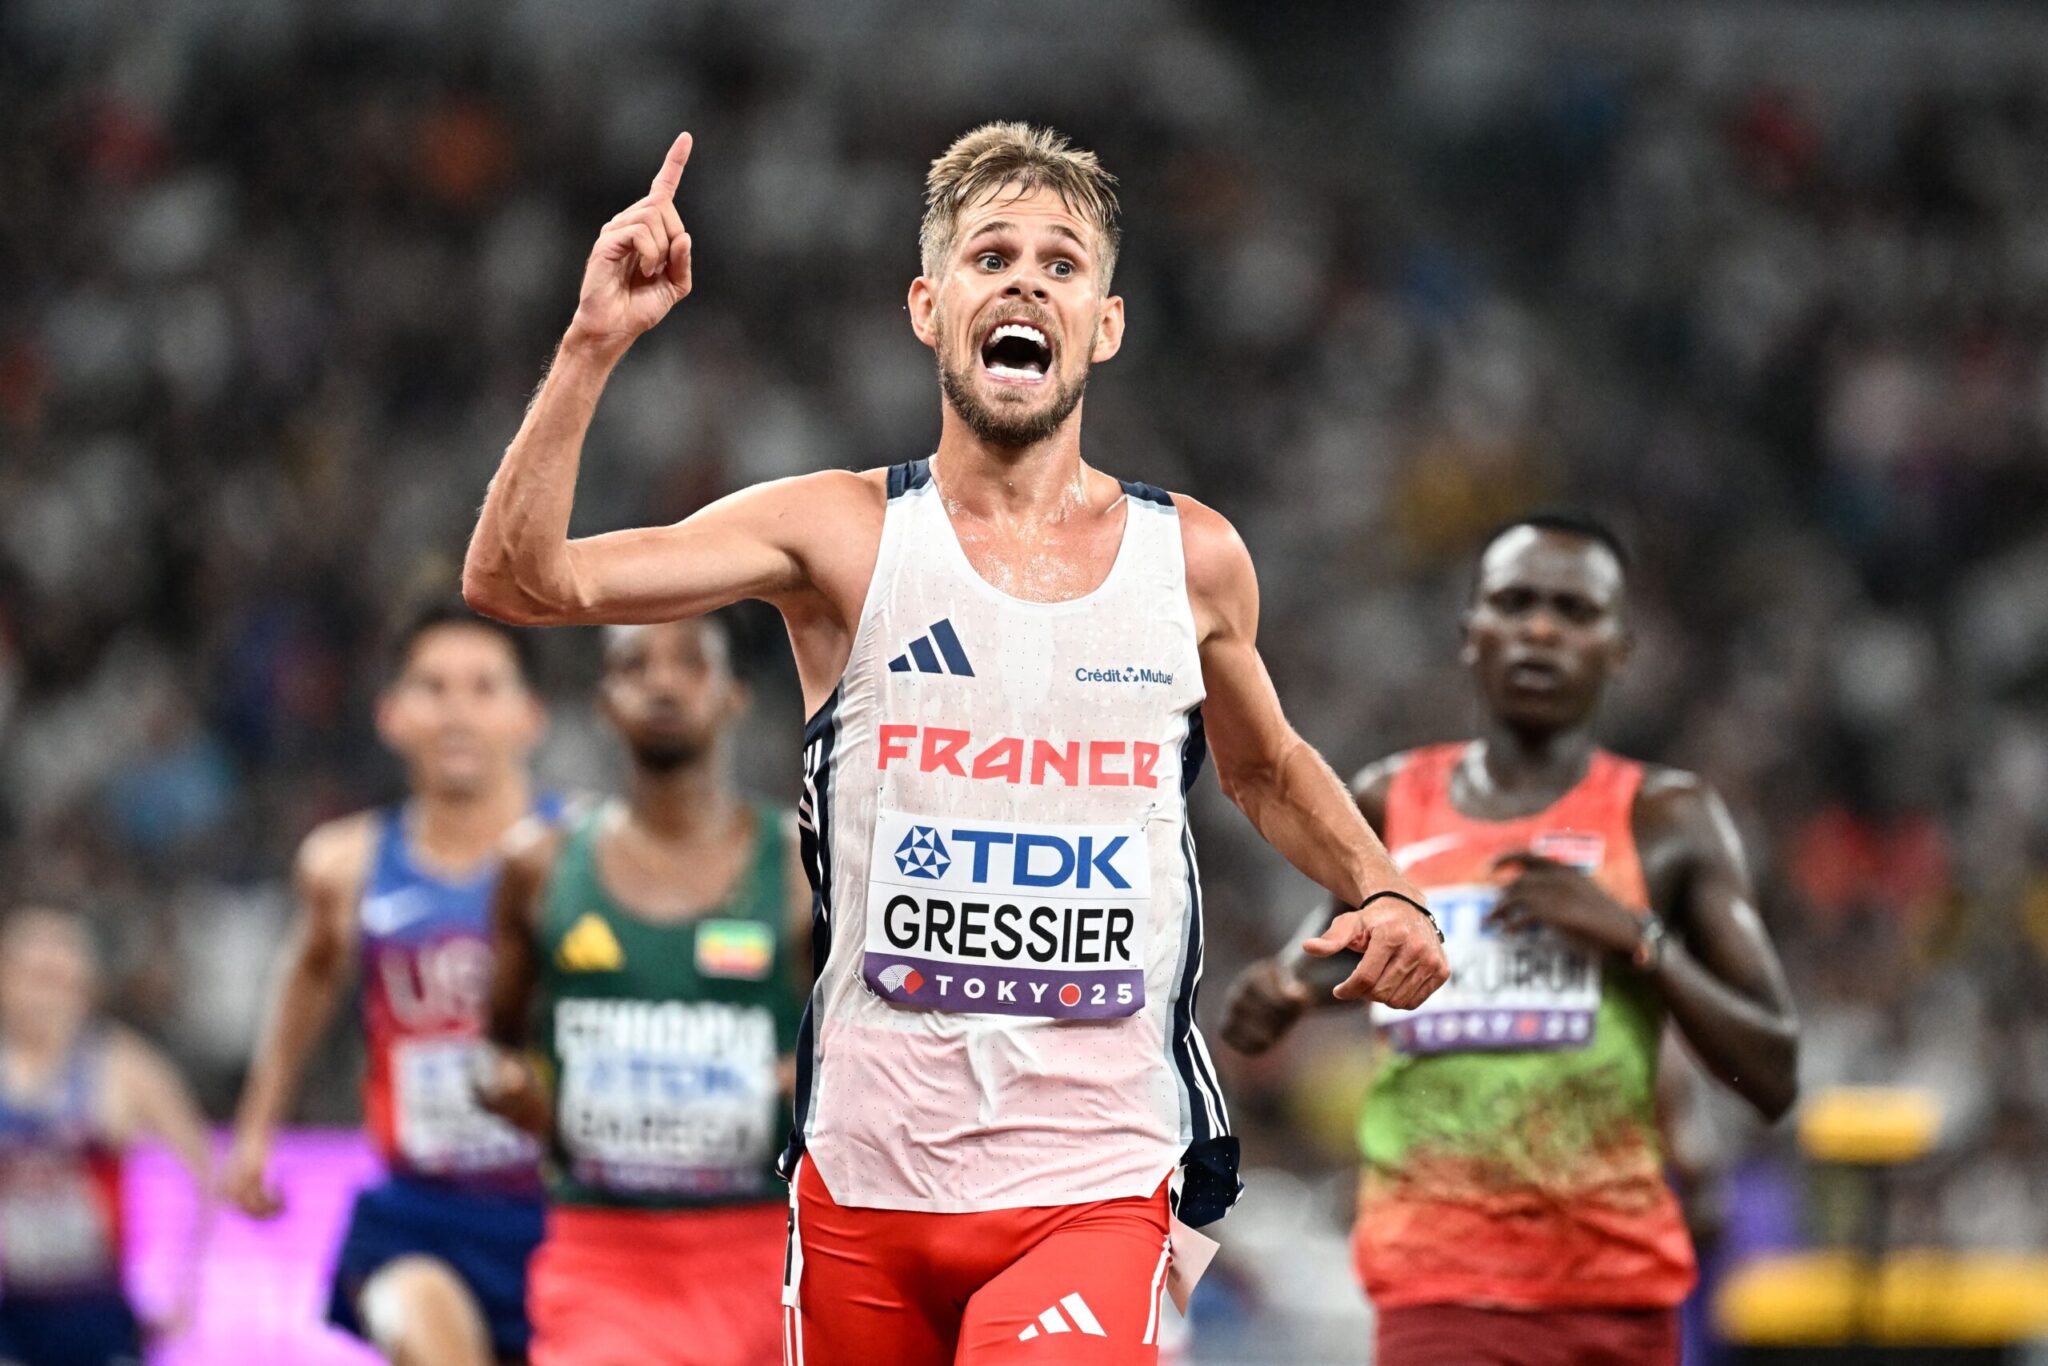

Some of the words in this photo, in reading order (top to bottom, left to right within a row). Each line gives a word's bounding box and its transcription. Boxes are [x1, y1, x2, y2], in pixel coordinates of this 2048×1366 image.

[1075, 667, 1121, 682] Crédit
[1140, 668, 1174, 685] Mutuel
[877, 724, 1160, 789] FRANCE
[951, 829, 1132, 889] TDK
[883, 894, 1134, 963] GRESSIER
